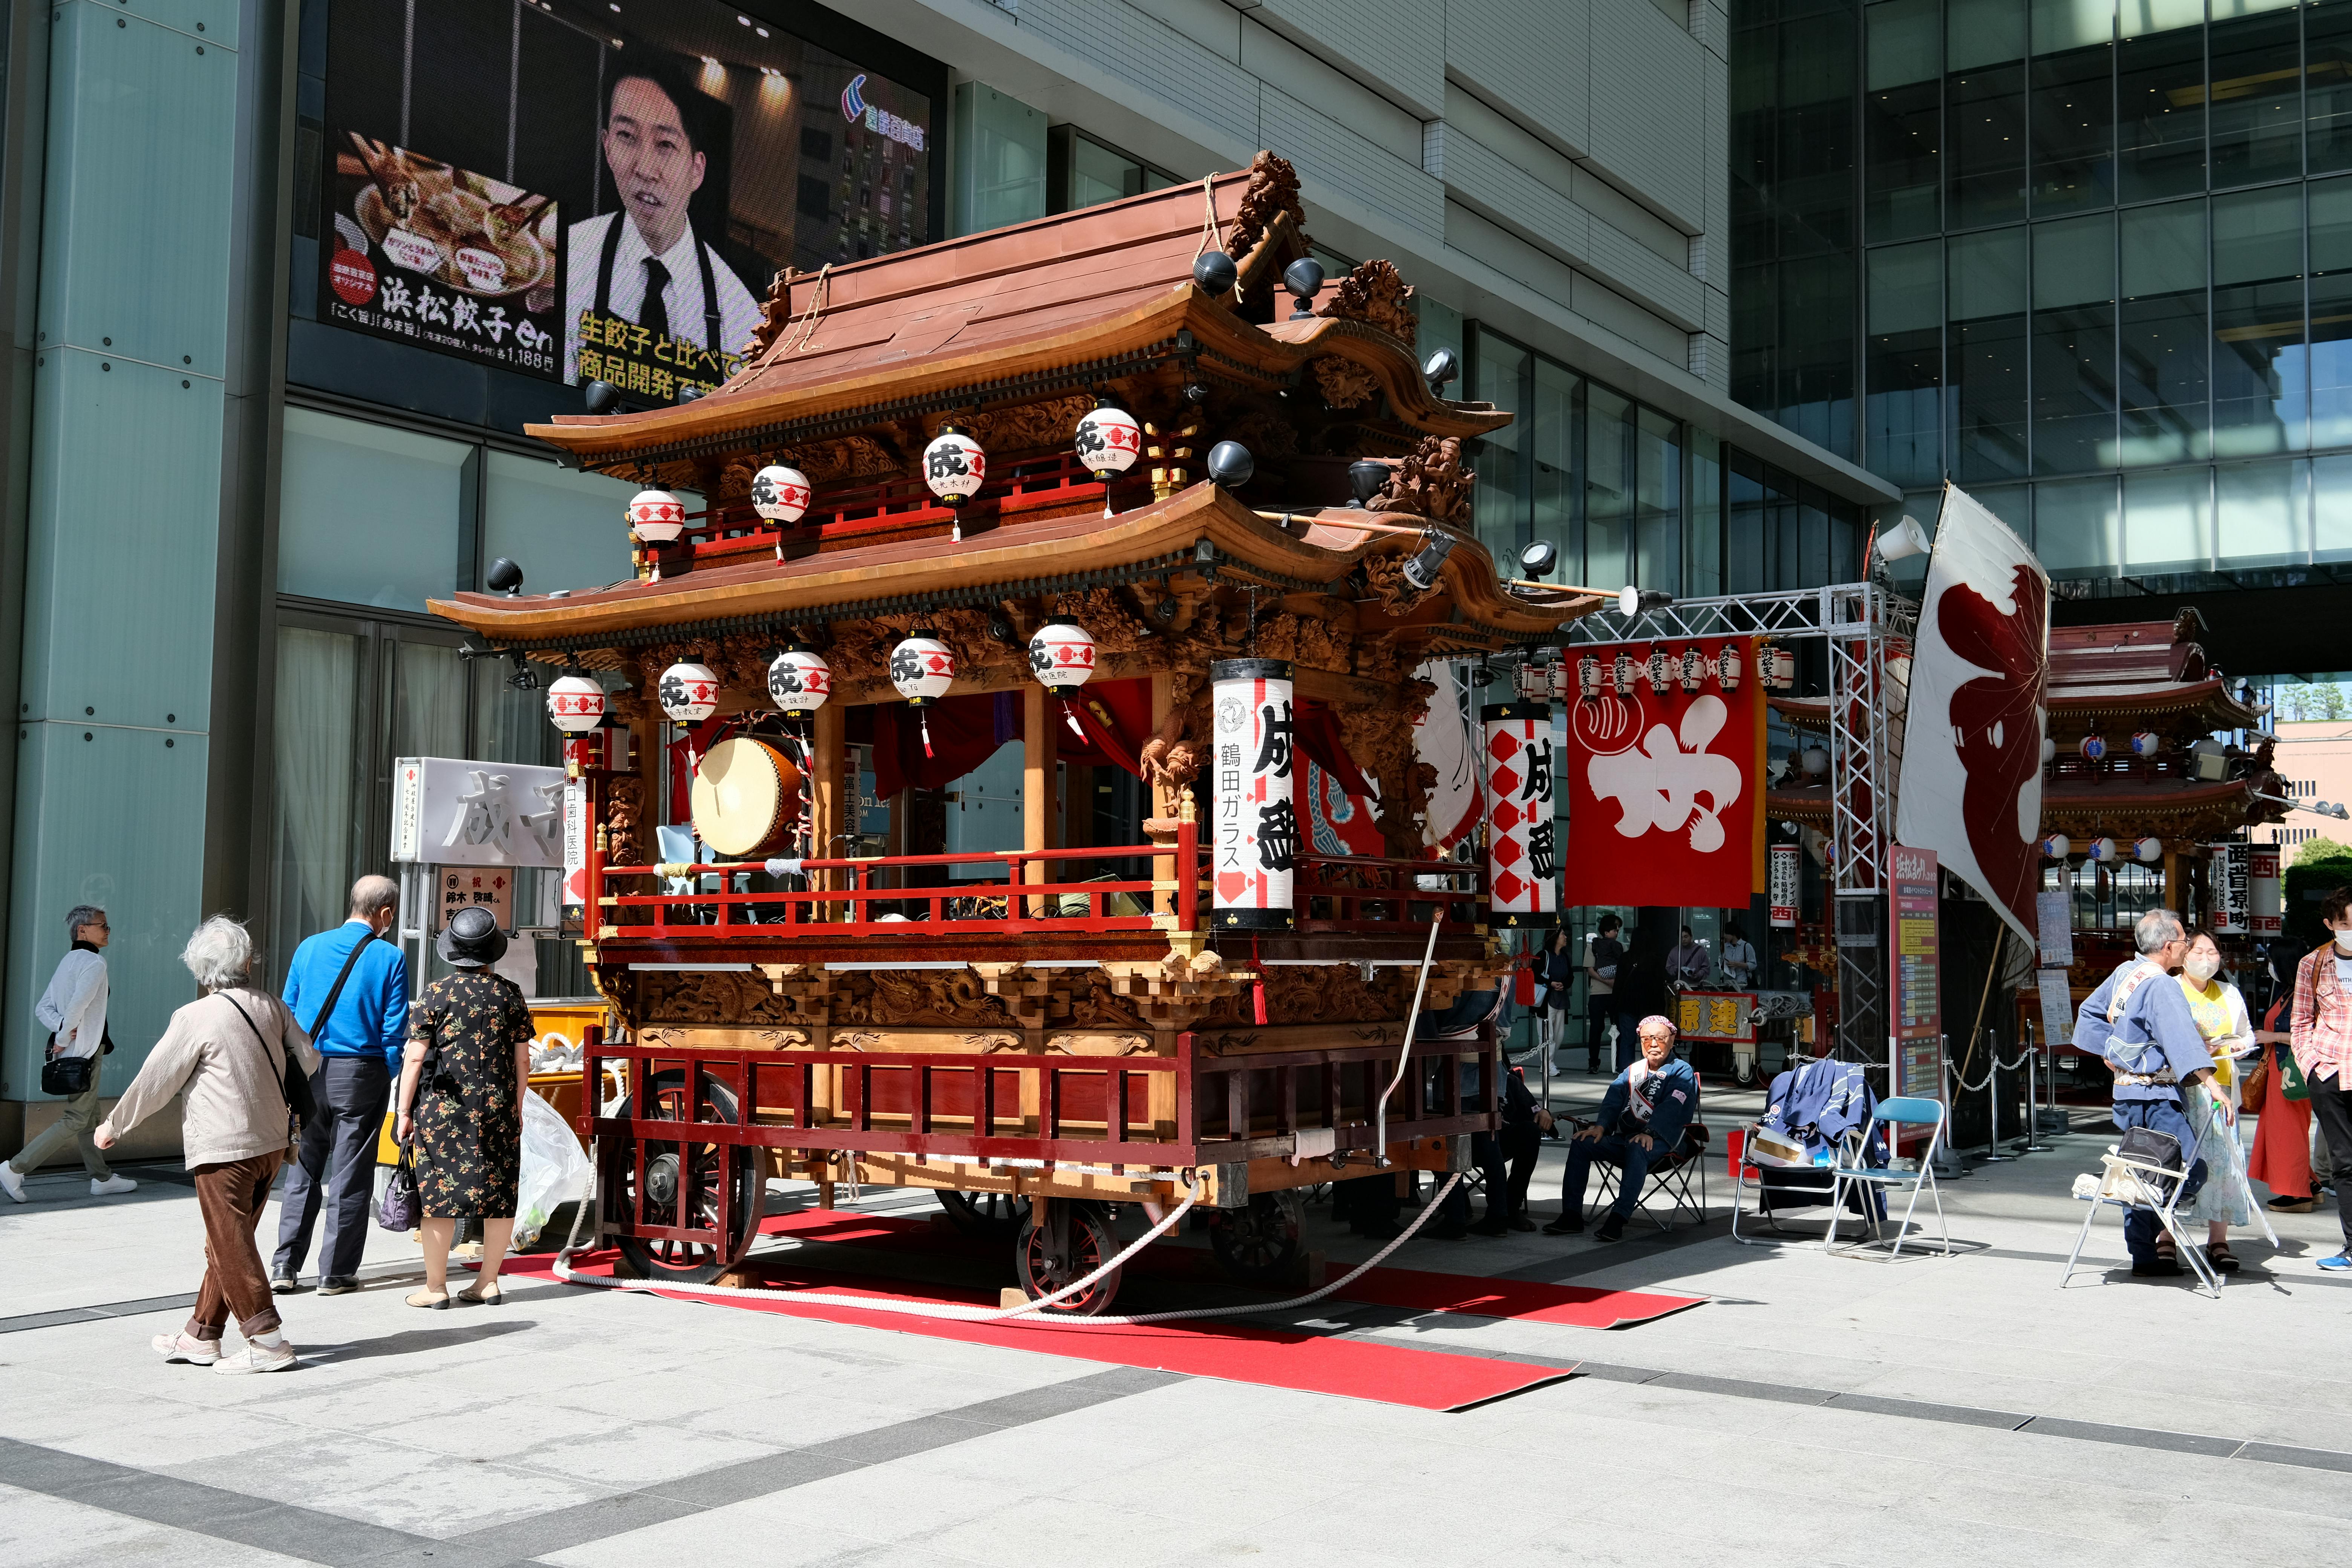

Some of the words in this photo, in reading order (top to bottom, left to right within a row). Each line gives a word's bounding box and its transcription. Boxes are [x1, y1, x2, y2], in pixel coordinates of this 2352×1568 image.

[579, 310, 752, 379] 生餃子と比べて
[932, 479, 969, 490] 三光木材
[1547, 663, 1558, 697] 浜松まつり
[1581, 660, 1593, 694] 浜松まつり
[1615, 658, 1627, 693] 浜松まつり
[1652, 655, 1663, 690] 浜松まつり
[1682, 652, 1696, 688] 浜松まつり
[1719, 650, 1732, 686] 浜松まつり
[1761, 649, 1774, 686] 浜松まつり
[1221, 743, 1241, 867] 鶴田ガラス
[472, 877, 481, 888] 祝
[1896, 853, 1925, 881] 浜松まつり
[446, 891, 467, 904] 鈴木
[446, 908, 460, 921] 吉
[2280, 1067, 2296, 1090] R
